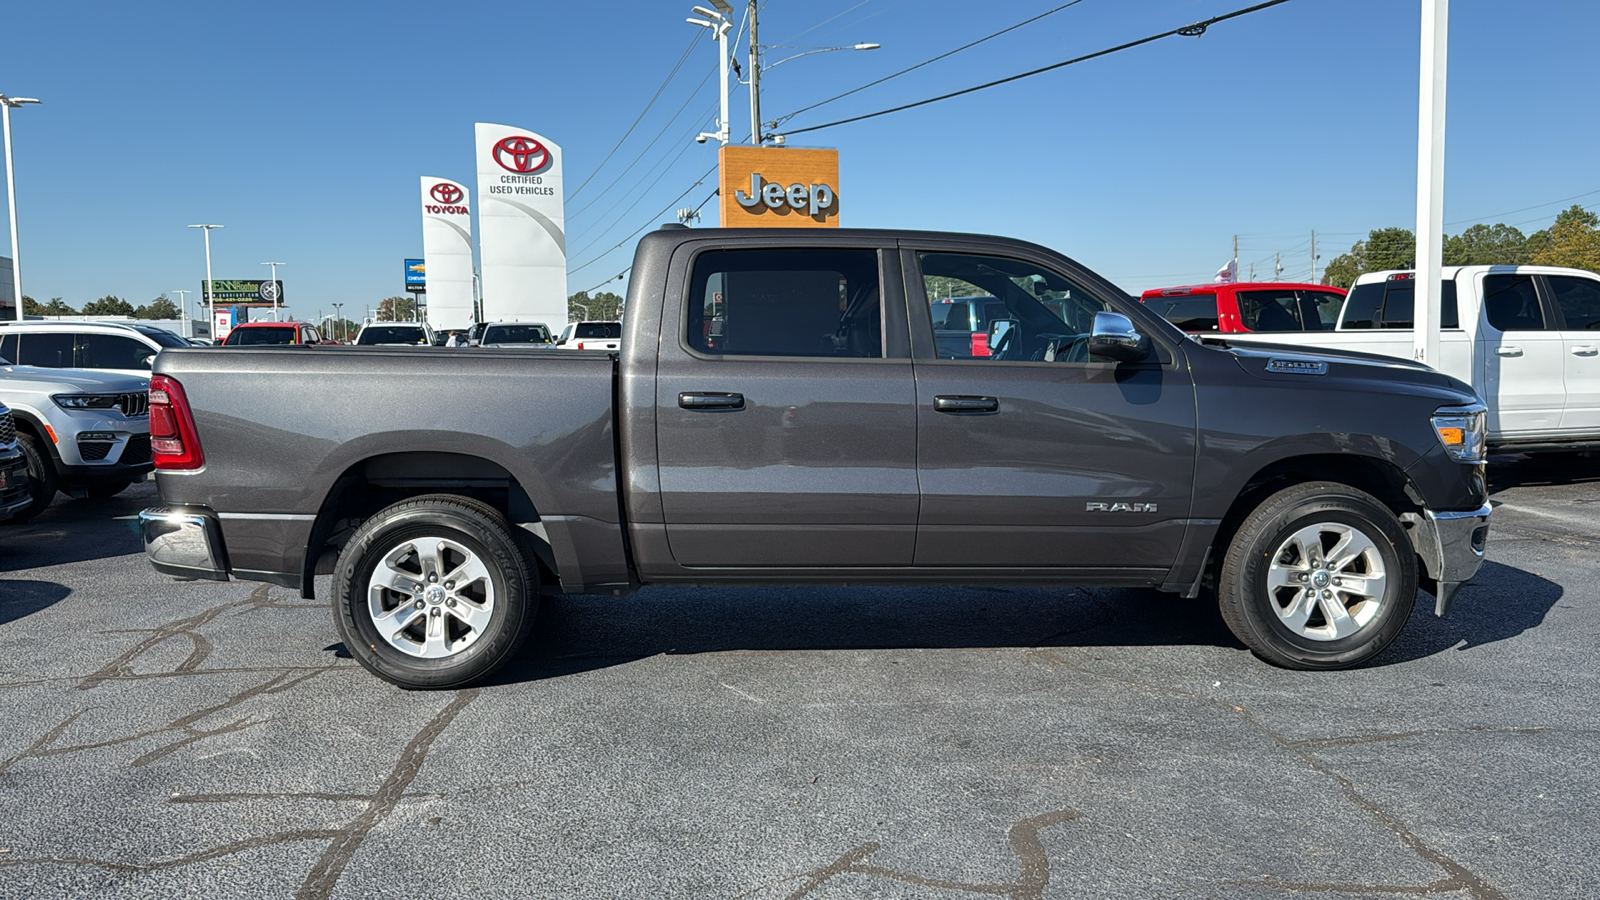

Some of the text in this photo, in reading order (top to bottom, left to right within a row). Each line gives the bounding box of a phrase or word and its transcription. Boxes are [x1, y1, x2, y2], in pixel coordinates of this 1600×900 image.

[500, 175, 543, 185] CERTIFIED
[489, 185, 554, 196] USED VEHICLES
[735, 173, 832, 214] Jeep
[425, 205, 470, 215] TOYOTA
[236, 282, 259, 292] Roofing
[1414, 348, 1424, 361] A4
[1086, 502, 1158, 512] RAM
